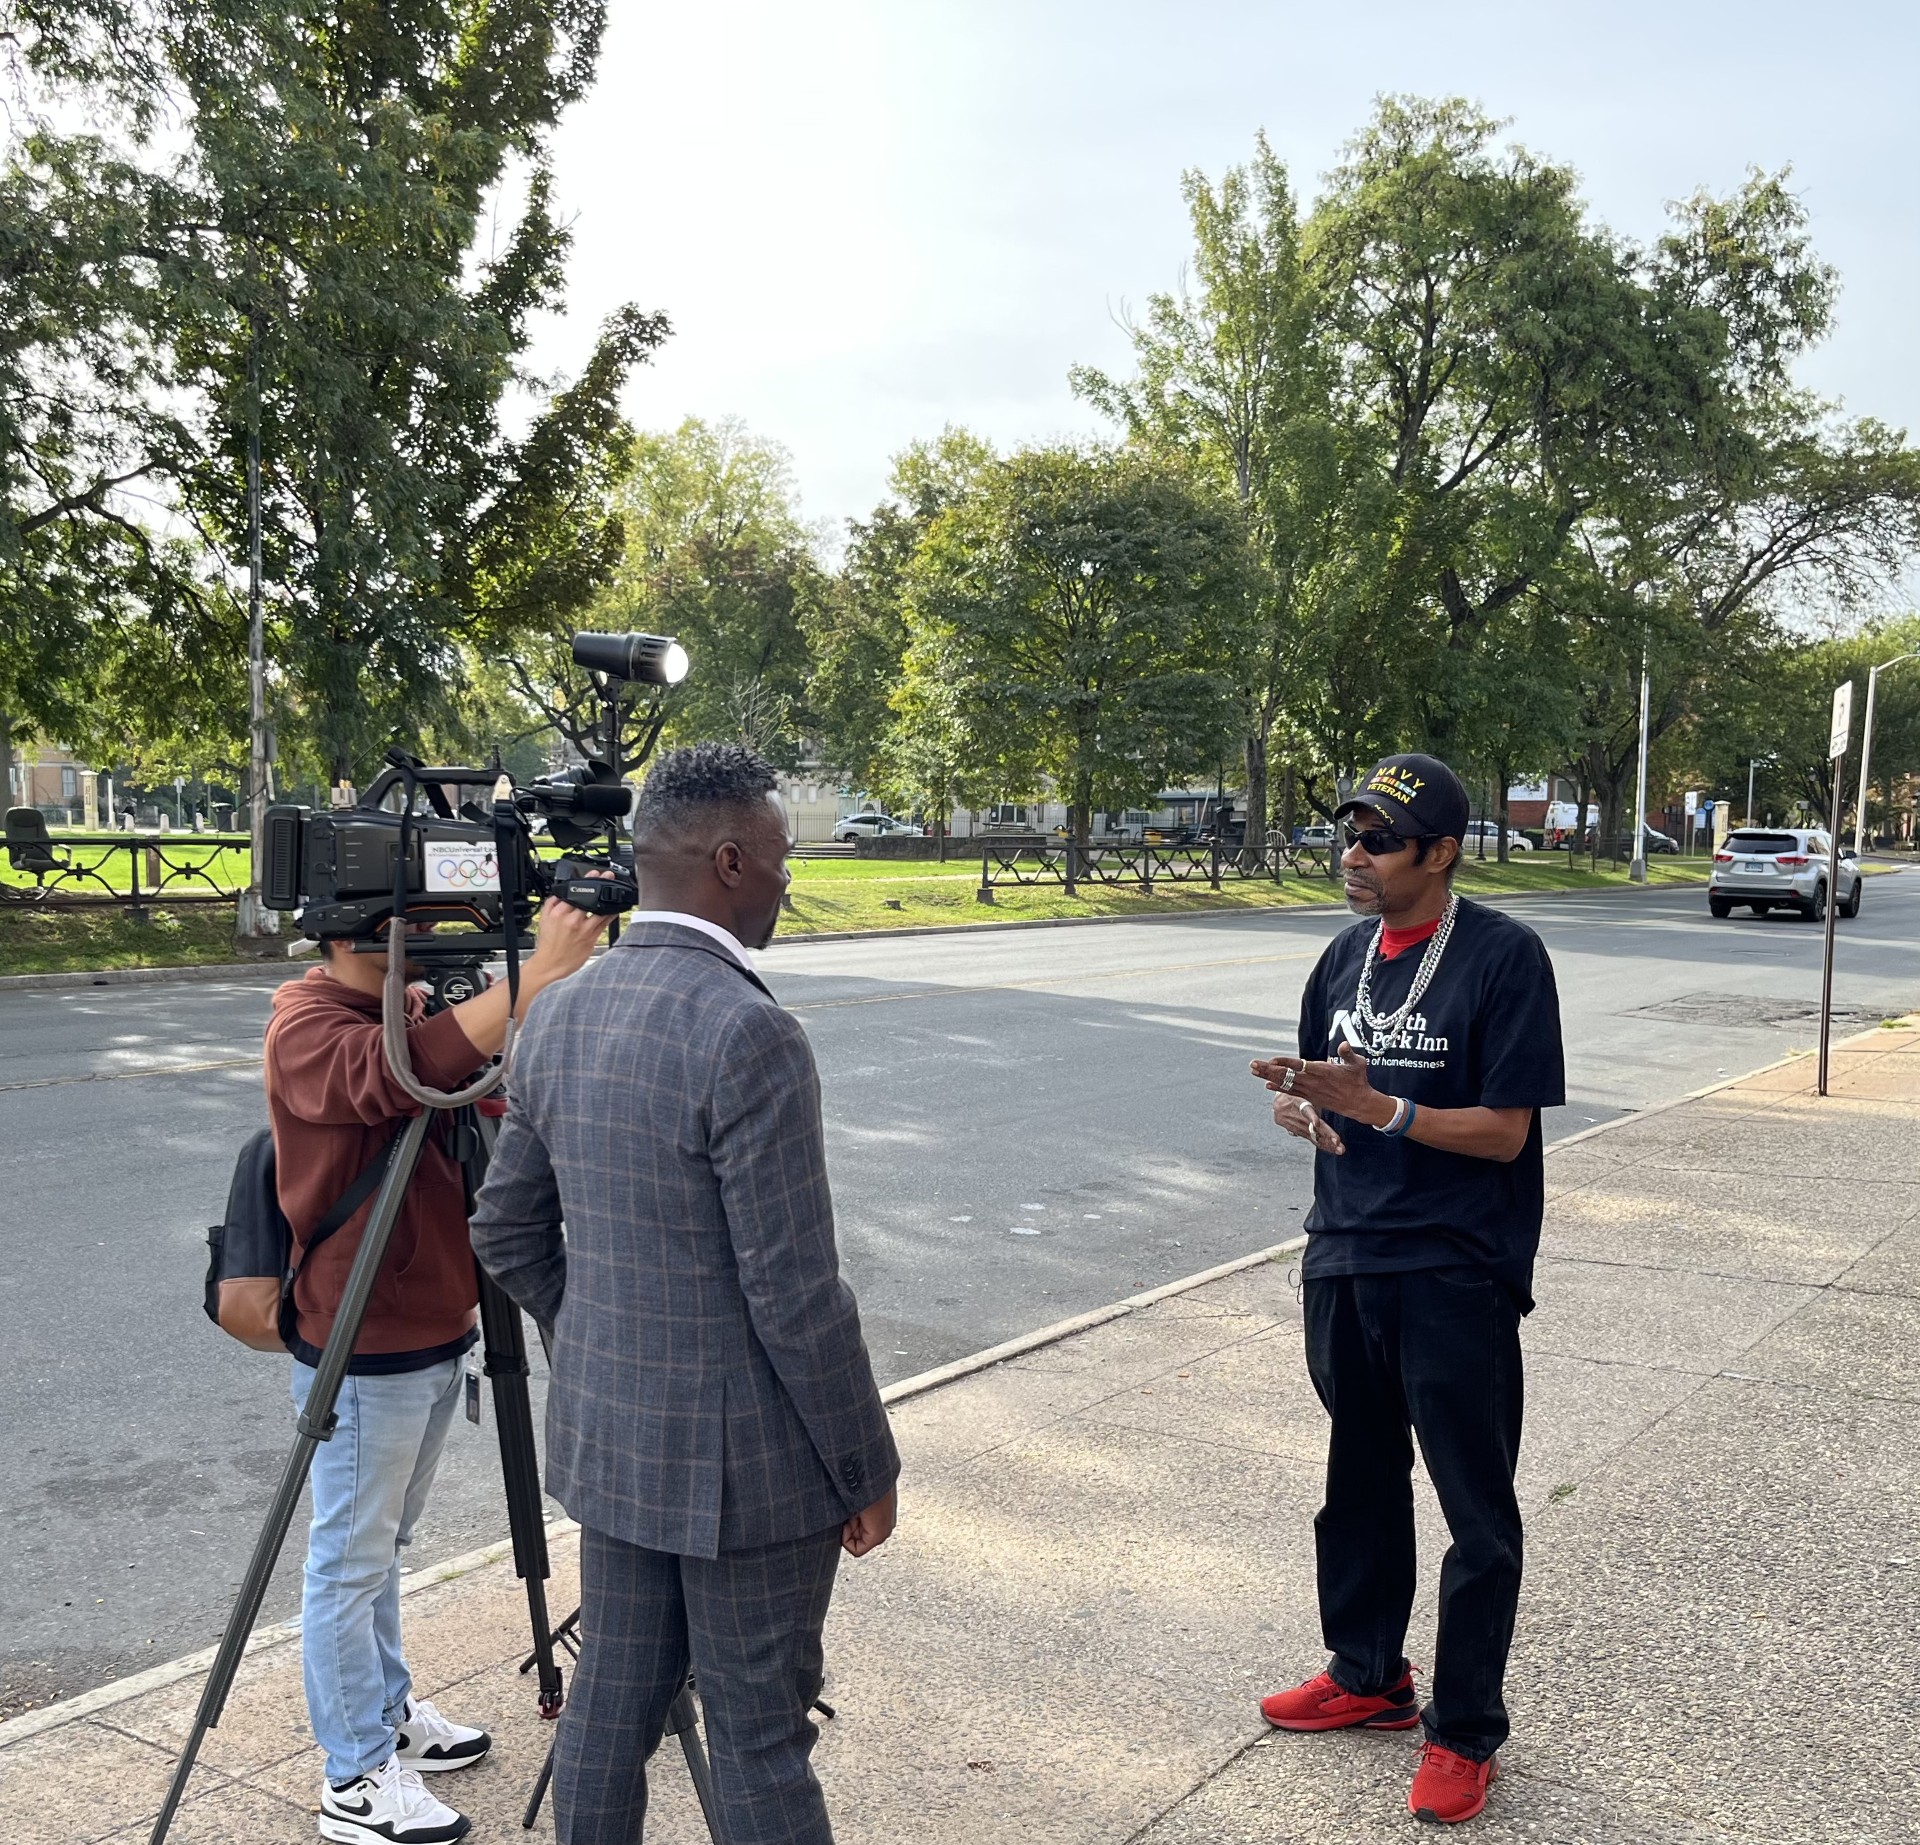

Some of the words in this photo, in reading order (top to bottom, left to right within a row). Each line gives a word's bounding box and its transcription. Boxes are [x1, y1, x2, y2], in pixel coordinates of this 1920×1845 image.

[1375, 766, 1425, 789] NAVY
[1366, 783, 1411, 804] VETERAN
[1374, 804, 1394, 824] NAVY
[1415, 1033, 1449, 1051] Inn
[1371, 1057, 1381, 1066] of
[1381, 1056, 1446, 1069] homelessness
